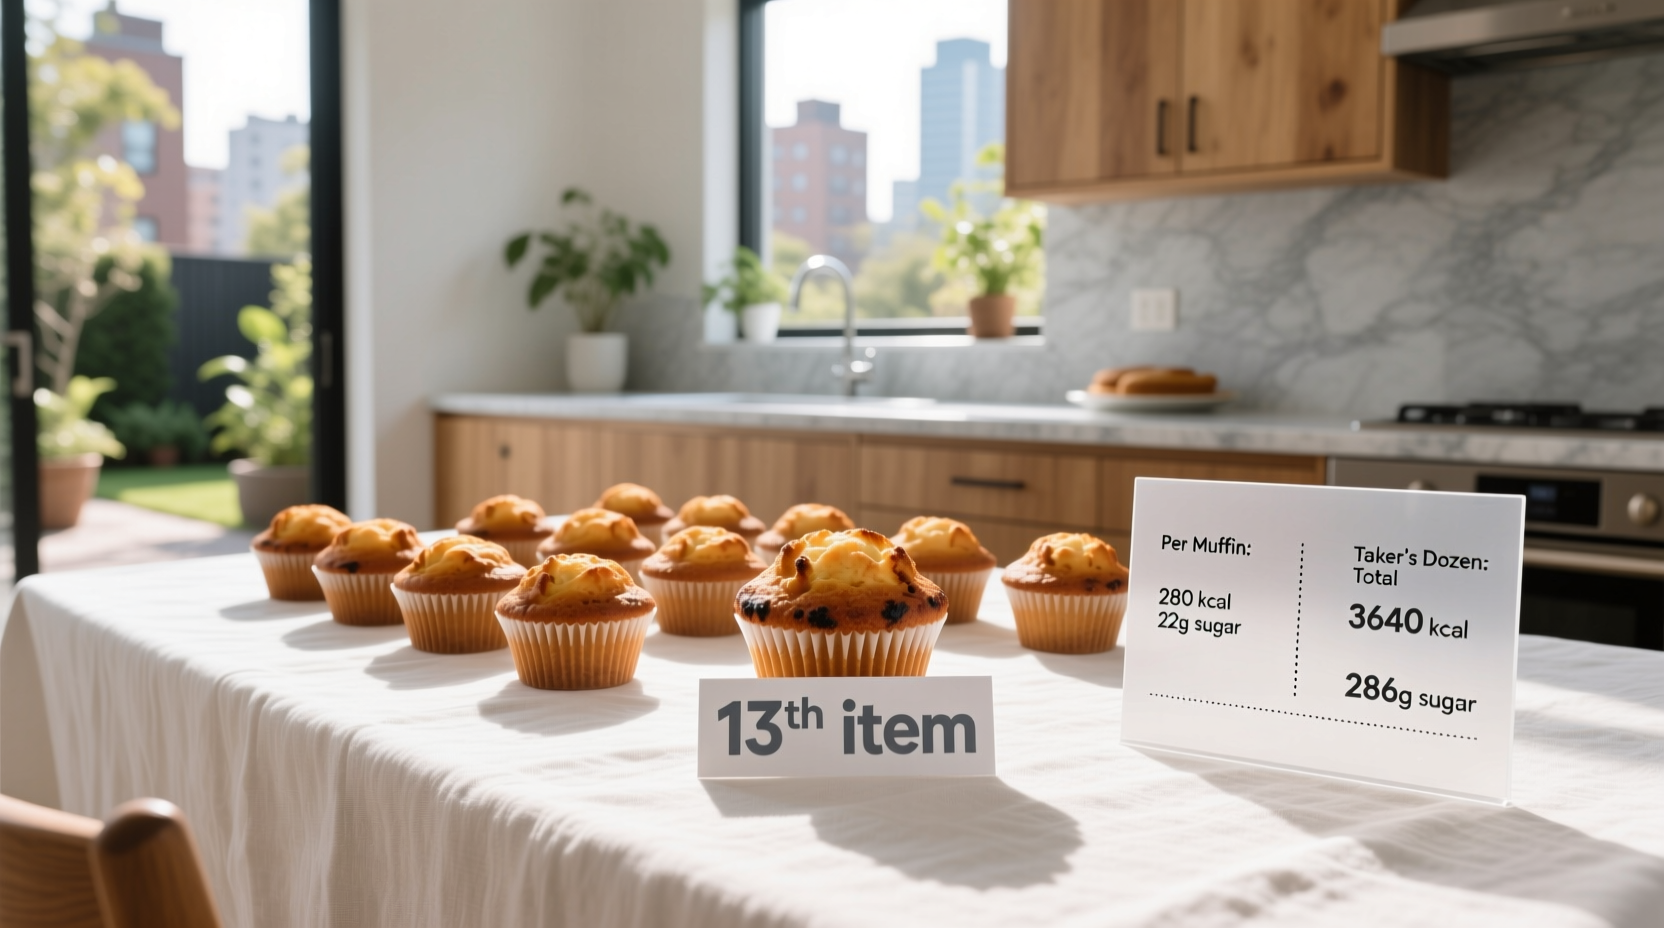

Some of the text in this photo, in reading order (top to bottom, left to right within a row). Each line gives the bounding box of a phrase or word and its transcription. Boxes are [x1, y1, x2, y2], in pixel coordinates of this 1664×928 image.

[1162, 535, 1251, 556] Per Muffin:
[1354, 546, 1488, 570] Taker's Dozen:
[1353, 567, 1397, 586] Total
[1159, 588, 1231, 610] 280 kcal
[1158, 612, 1241, 637] 22g sugar
[1349, 603, 1468, 638] 3640 kcal
[1345, 674, 1477, 715] 286g sugar
[718, 697, 976, 756] 13th item
